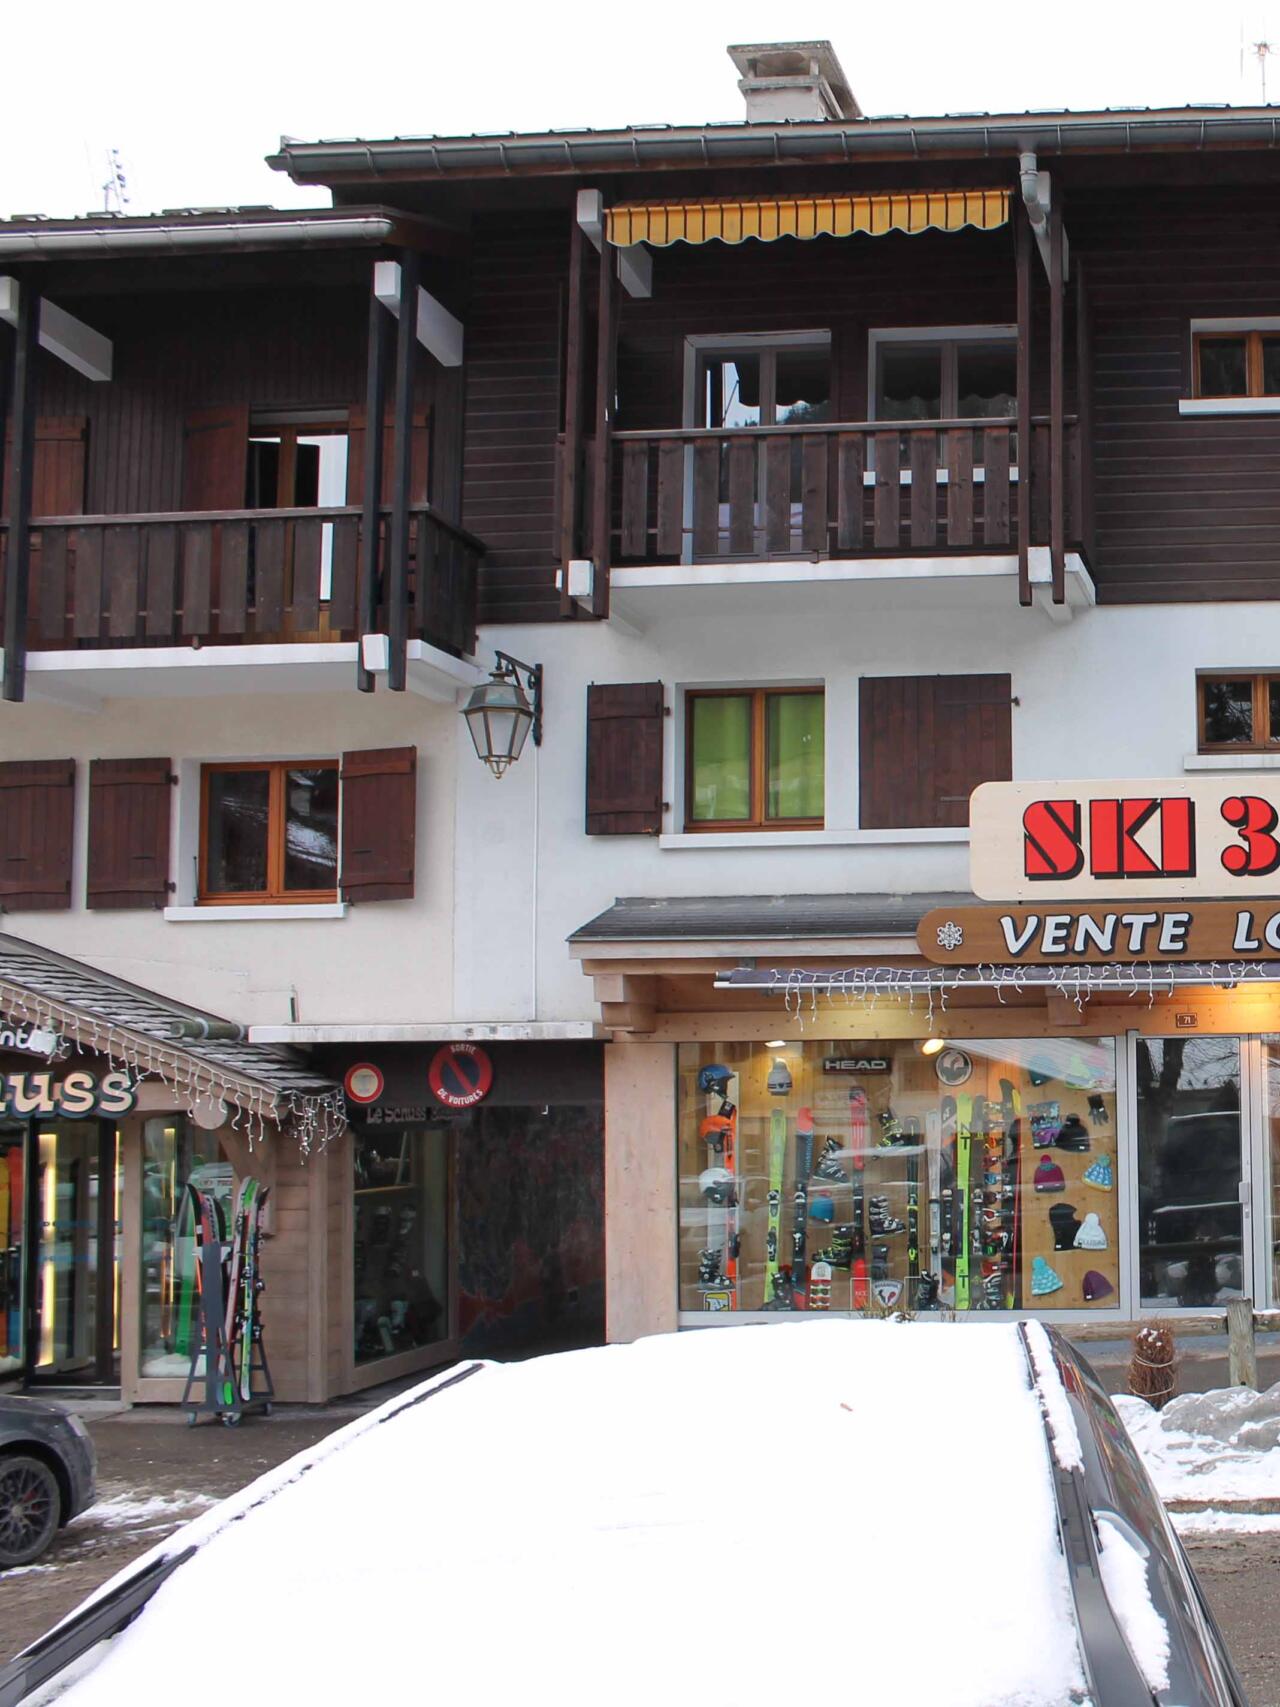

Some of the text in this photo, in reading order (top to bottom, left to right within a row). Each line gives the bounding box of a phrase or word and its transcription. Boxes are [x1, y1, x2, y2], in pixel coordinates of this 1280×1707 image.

[1022, 797, 1198, 881] SKI
[1000, 910, 1193, 957] VENTE
[1183, 1016, 1191, 1024] 71
[825, 1060, 887, 1070] HEAD
[0, 1072, 136, 1115] uss
[437, 1088, 484, 1105] DE VOITURES
